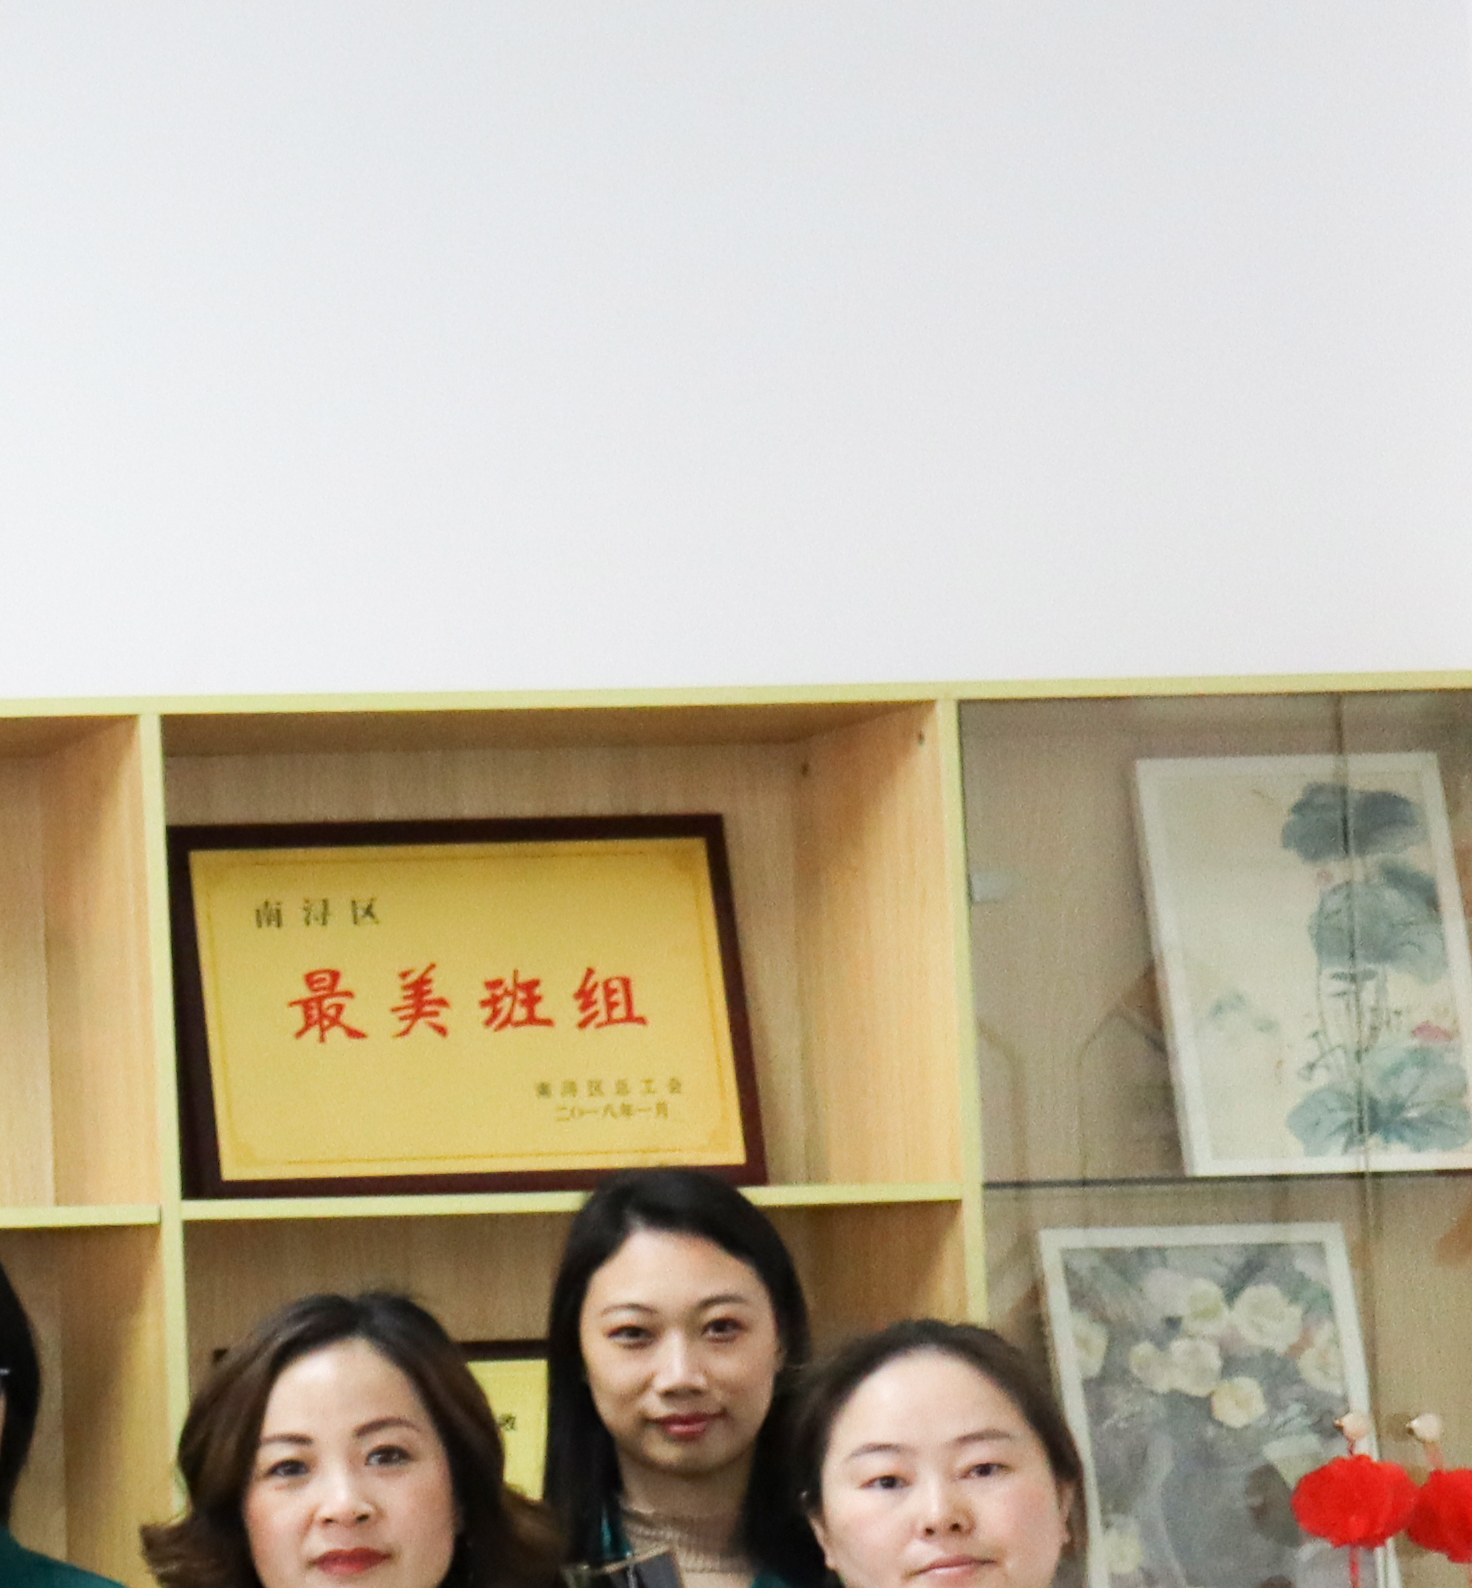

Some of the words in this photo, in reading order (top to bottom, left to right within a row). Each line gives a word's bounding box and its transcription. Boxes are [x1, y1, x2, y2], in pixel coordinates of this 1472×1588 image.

[254, 897, 380, 929] 南浔区
[287, 962, 649, 1044] 最美班组
